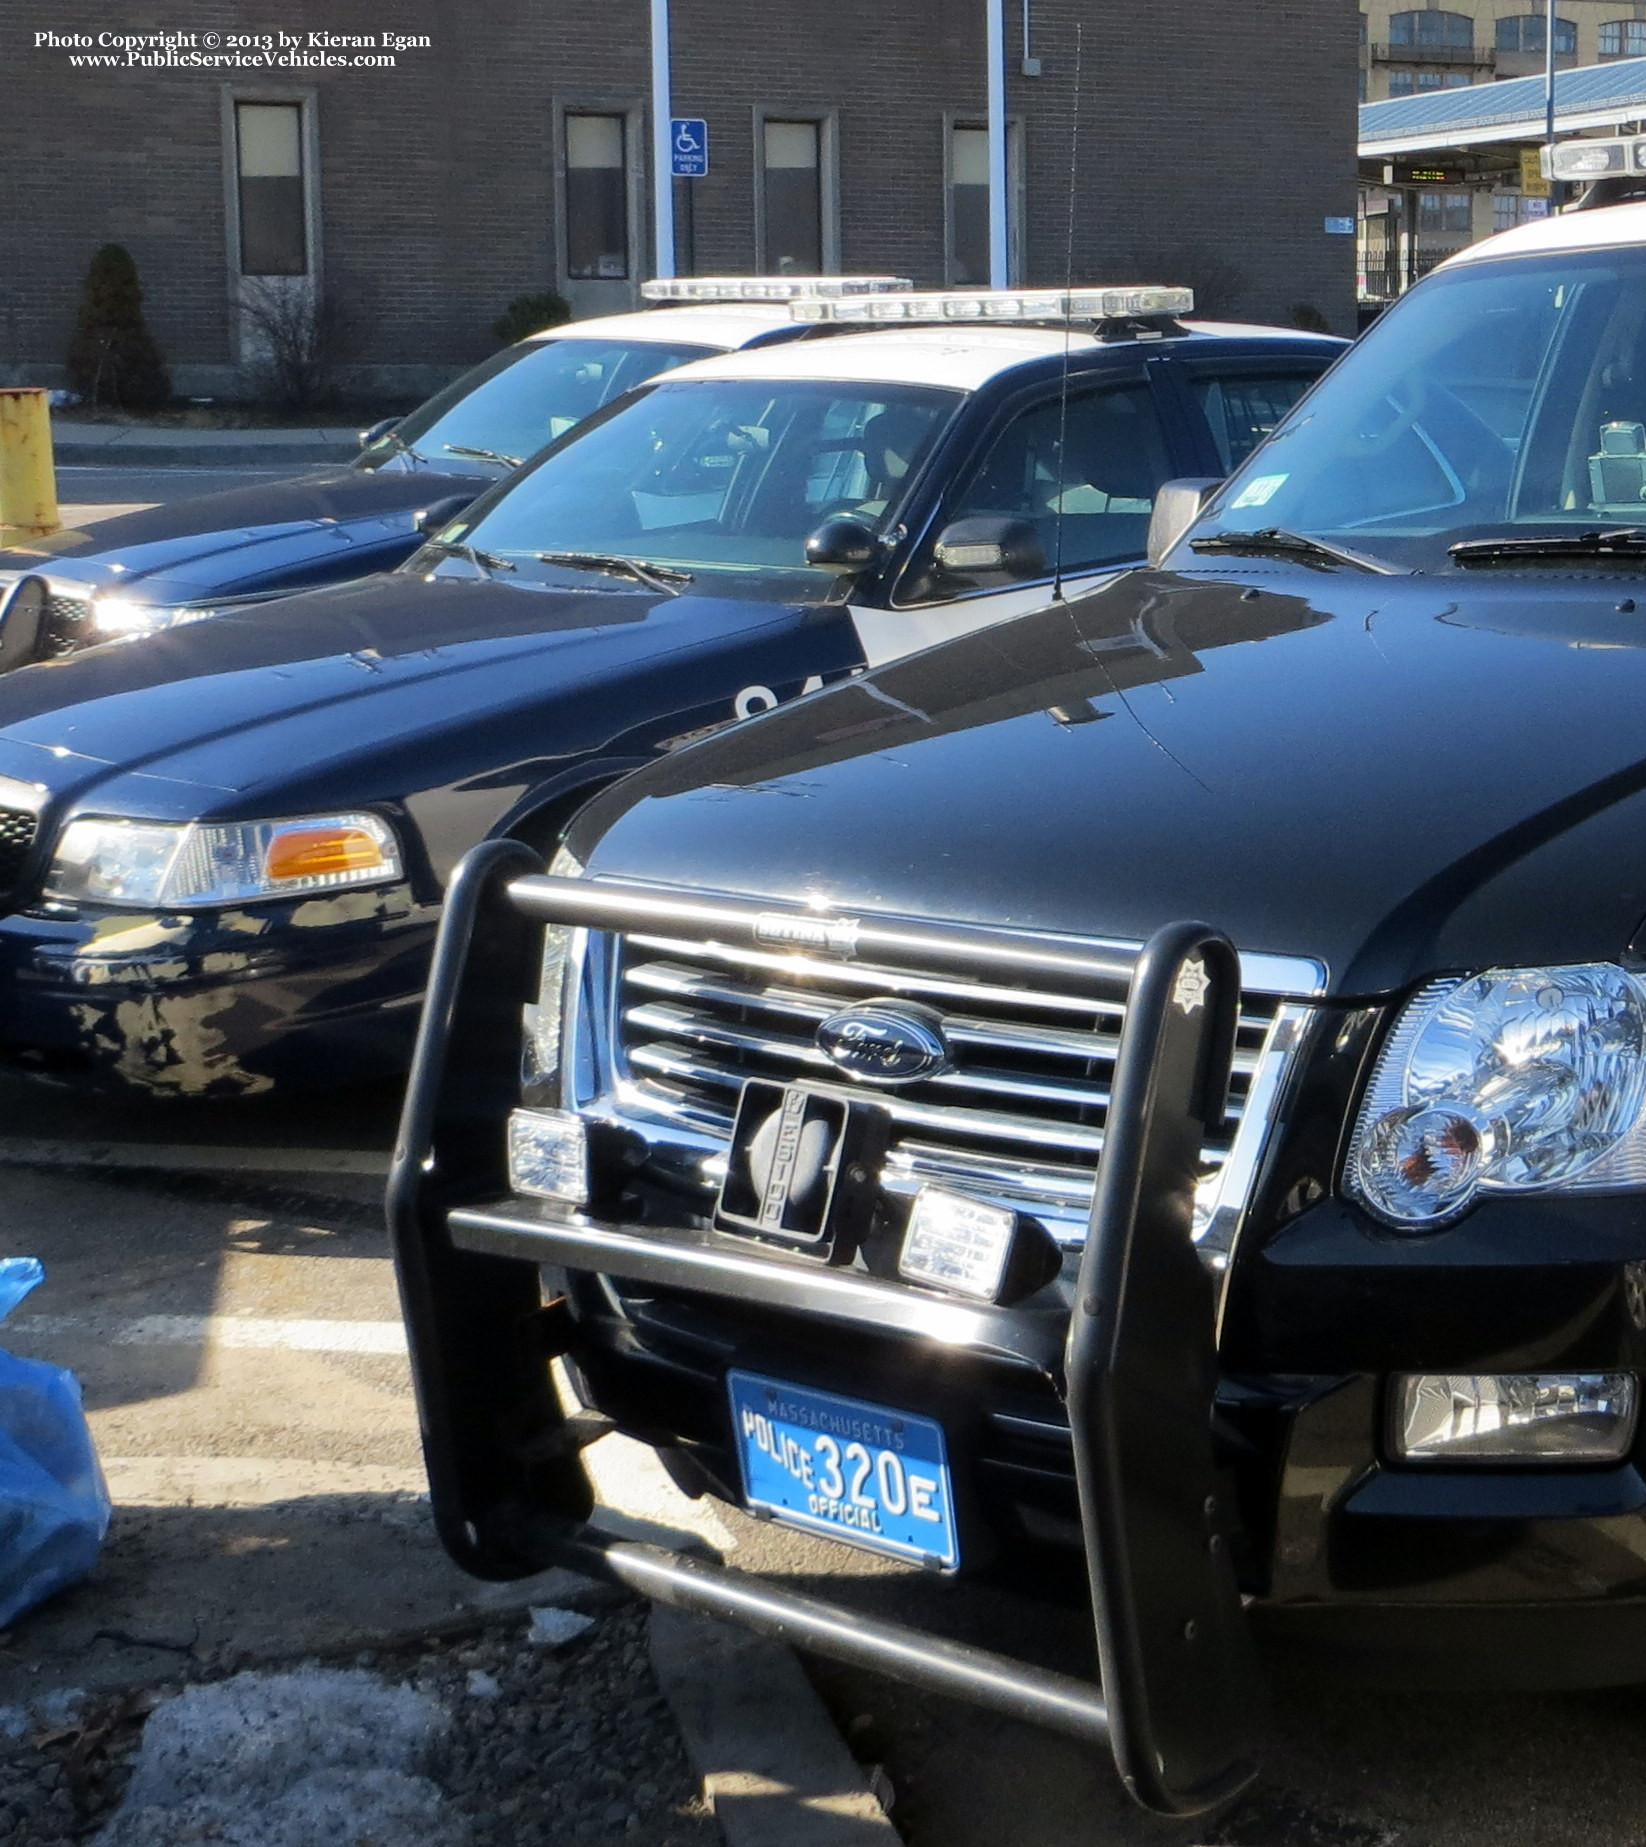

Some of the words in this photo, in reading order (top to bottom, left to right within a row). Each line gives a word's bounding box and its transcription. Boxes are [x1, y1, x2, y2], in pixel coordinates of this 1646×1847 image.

[836, 1022, 904, 1070] Ford
[767, 1401, 906, 1451] MASSACHUSETTS
[742, 1405, 816, 1491] POLICE
[814, 1434, 943, 1523] 320E
[807, 1493, 884, 1534] OFFICIAL
